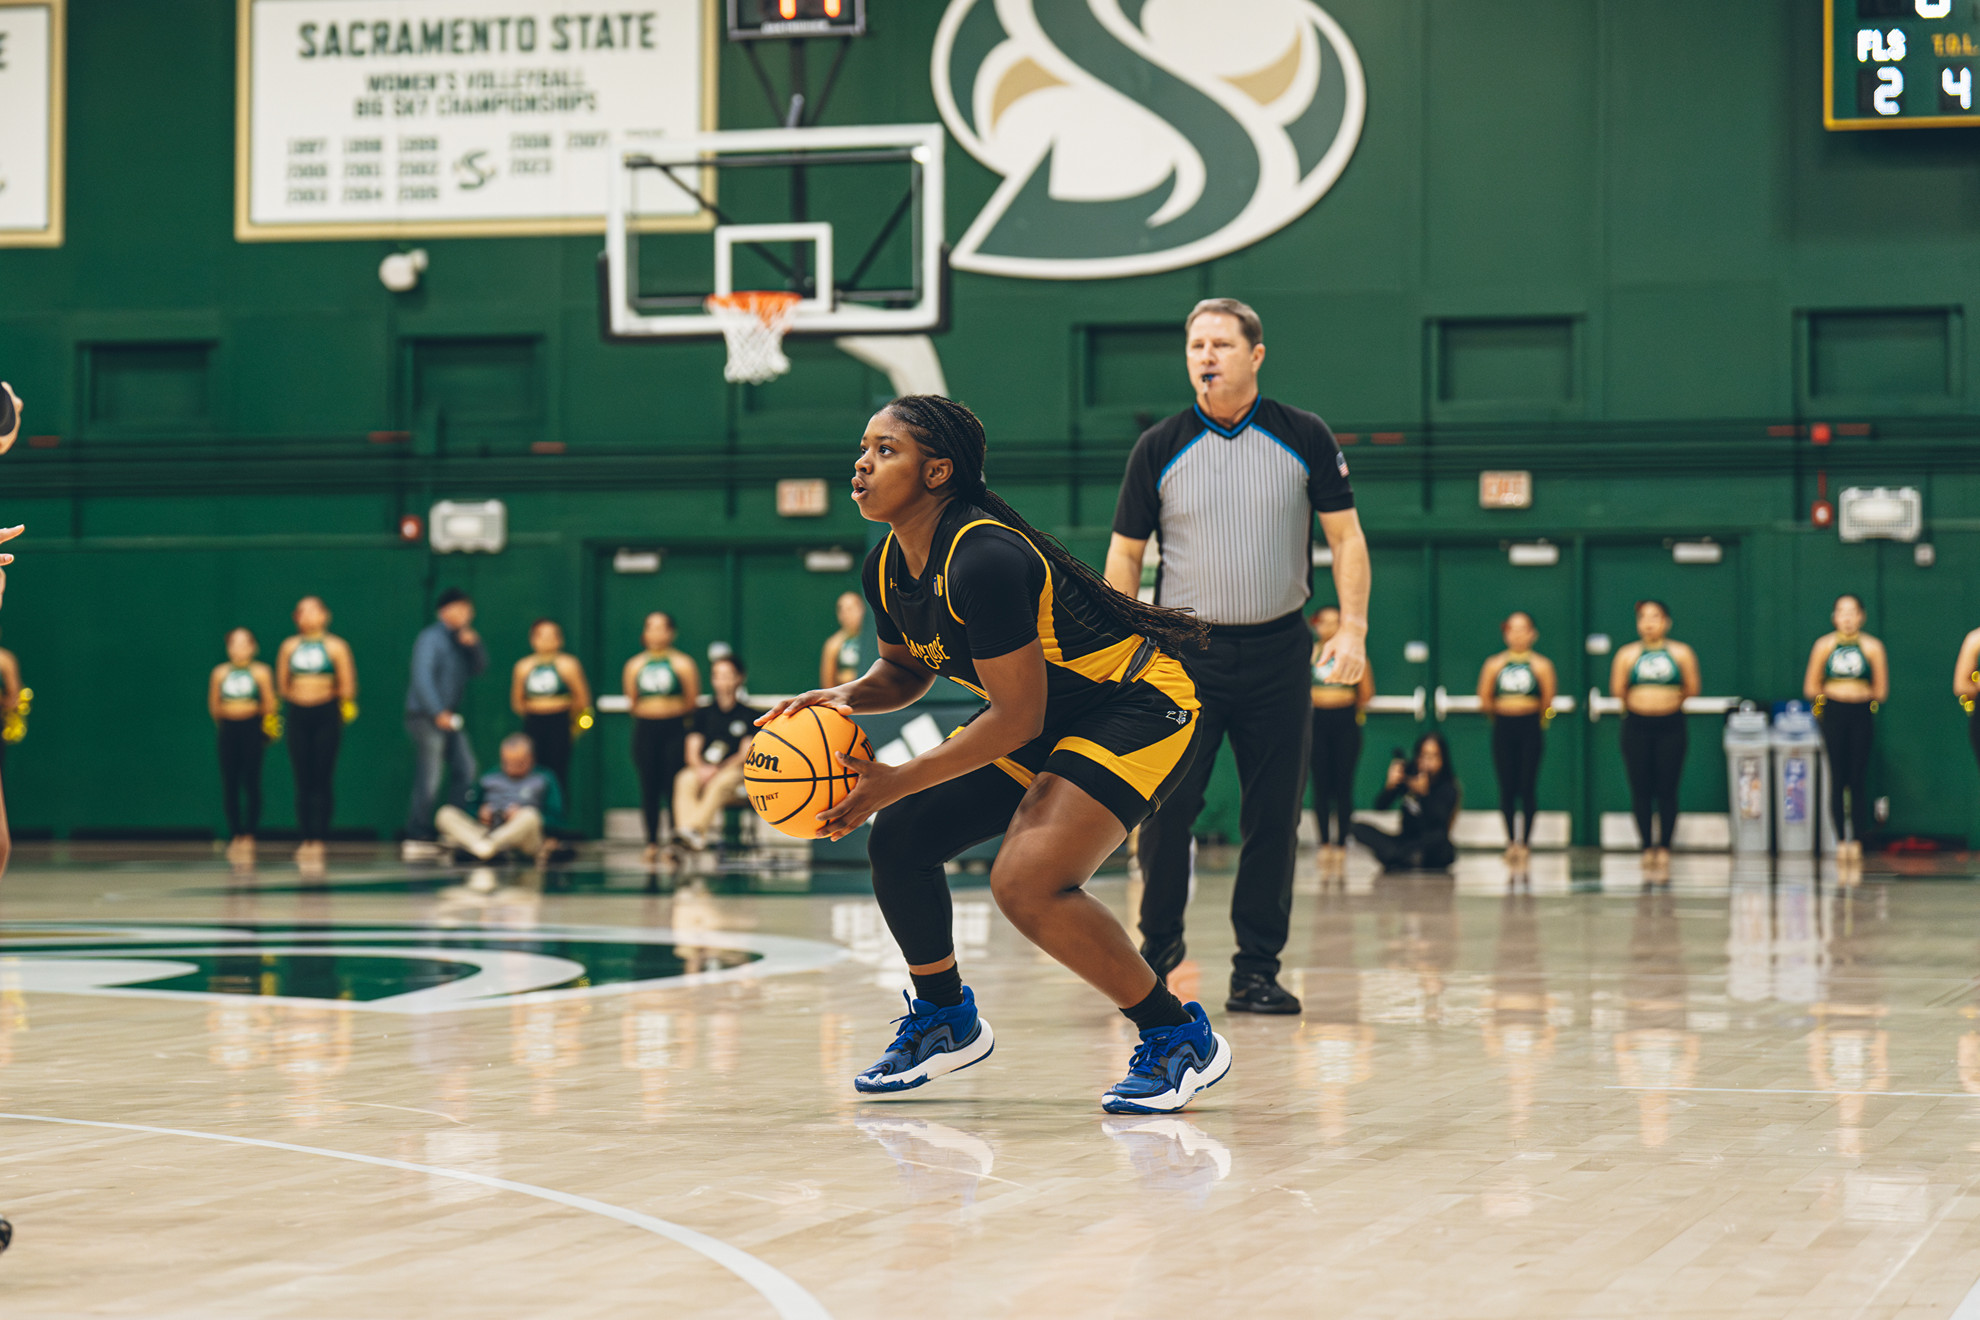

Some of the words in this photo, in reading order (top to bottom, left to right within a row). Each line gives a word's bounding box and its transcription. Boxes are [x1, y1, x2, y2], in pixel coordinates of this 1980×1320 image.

[299, 19, 537, 58] SACRAMENTO
[550, 12, 658, 52] STATE
[1874, 66, 1904, 115] 2
[1942, 67, 1972, 109] 4
